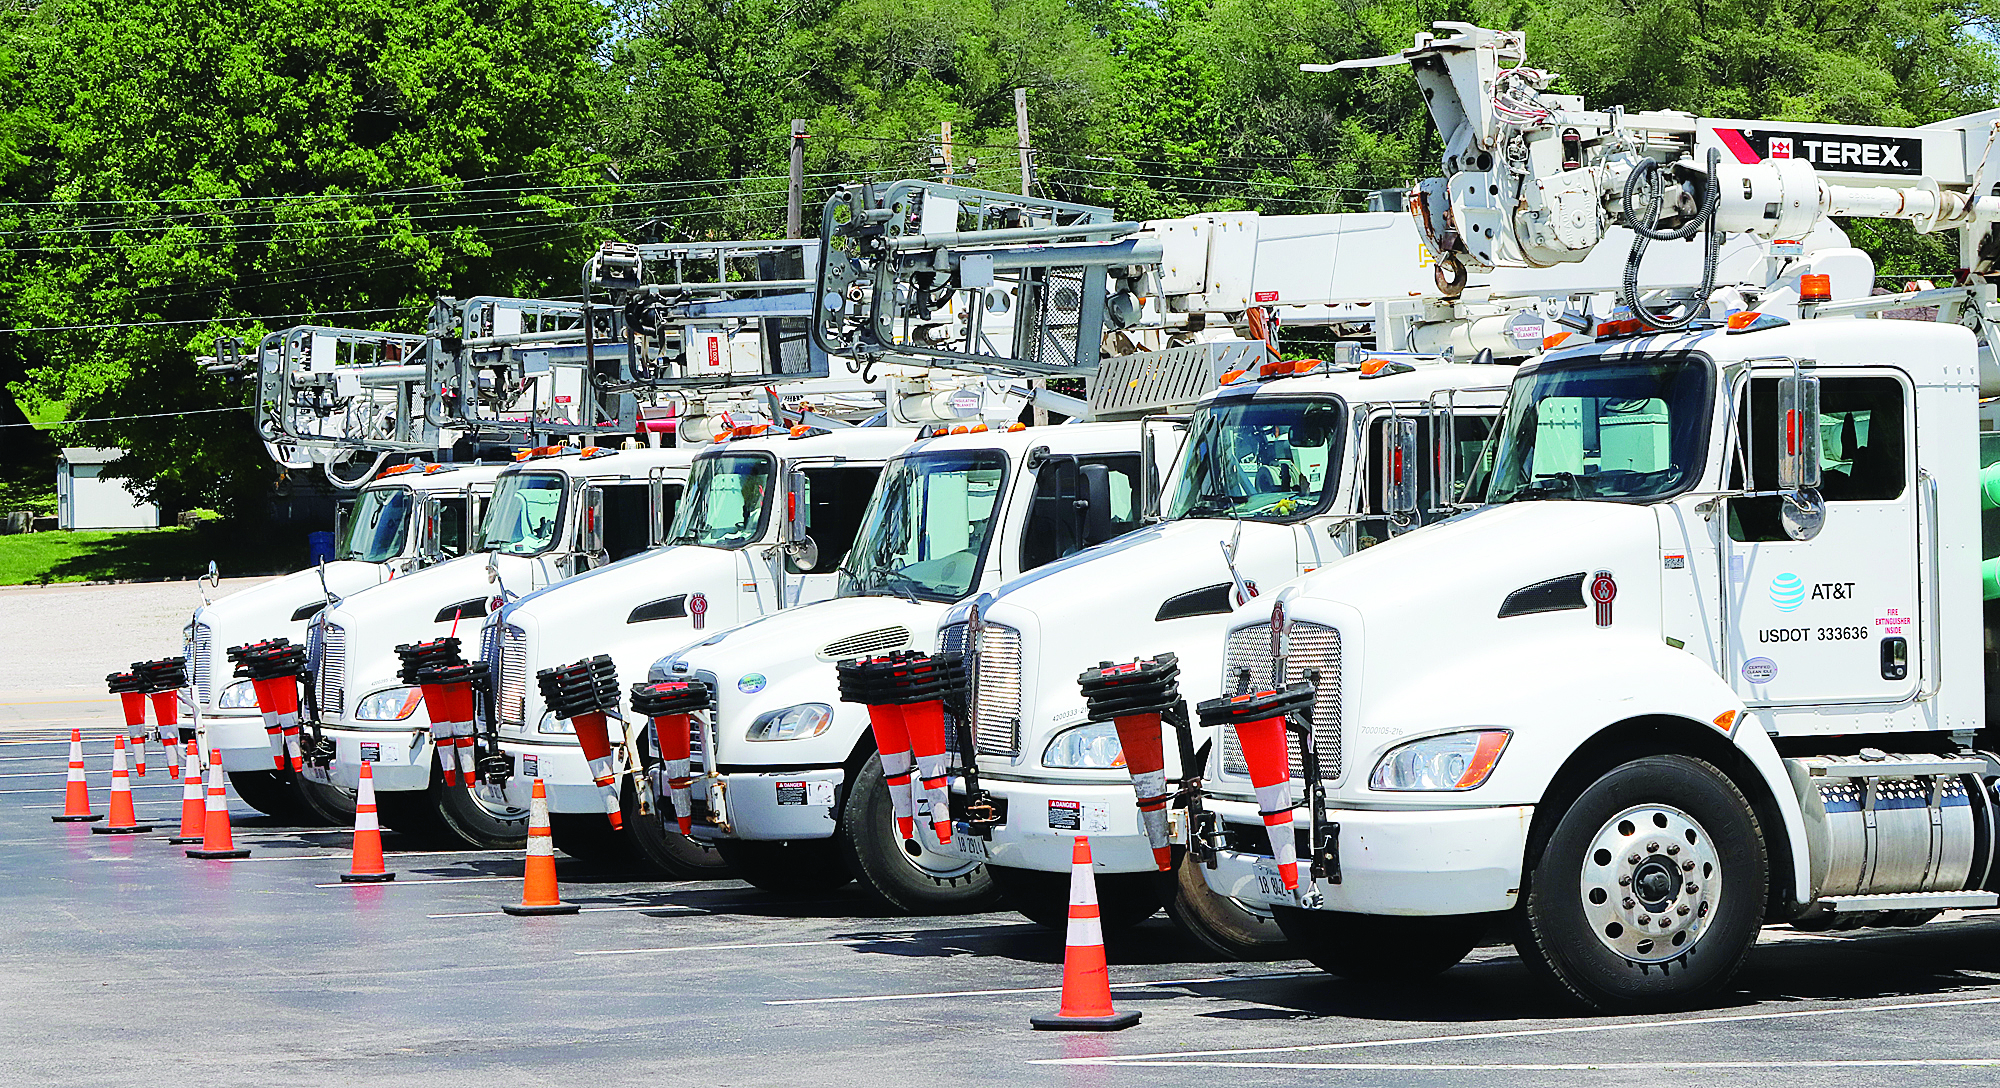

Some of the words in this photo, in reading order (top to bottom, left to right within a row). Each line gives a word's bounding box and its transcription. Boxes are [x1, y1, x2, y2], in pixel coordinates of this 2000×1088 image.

[1811, 583, 1856, 600] AT&T
[1887, 608, 1899, 616] FIRE
[1875, 617, 1911, 625] EXTINGUISHER
[1884, 626, 1902, 634] INSIDE
[1759, 628, 1811, 643] USDOT
[1817, 626, 1869, 641] 333636
[1055, 801, 1077, 809] DANGER
[1258, 875, 1270, 894] 18
